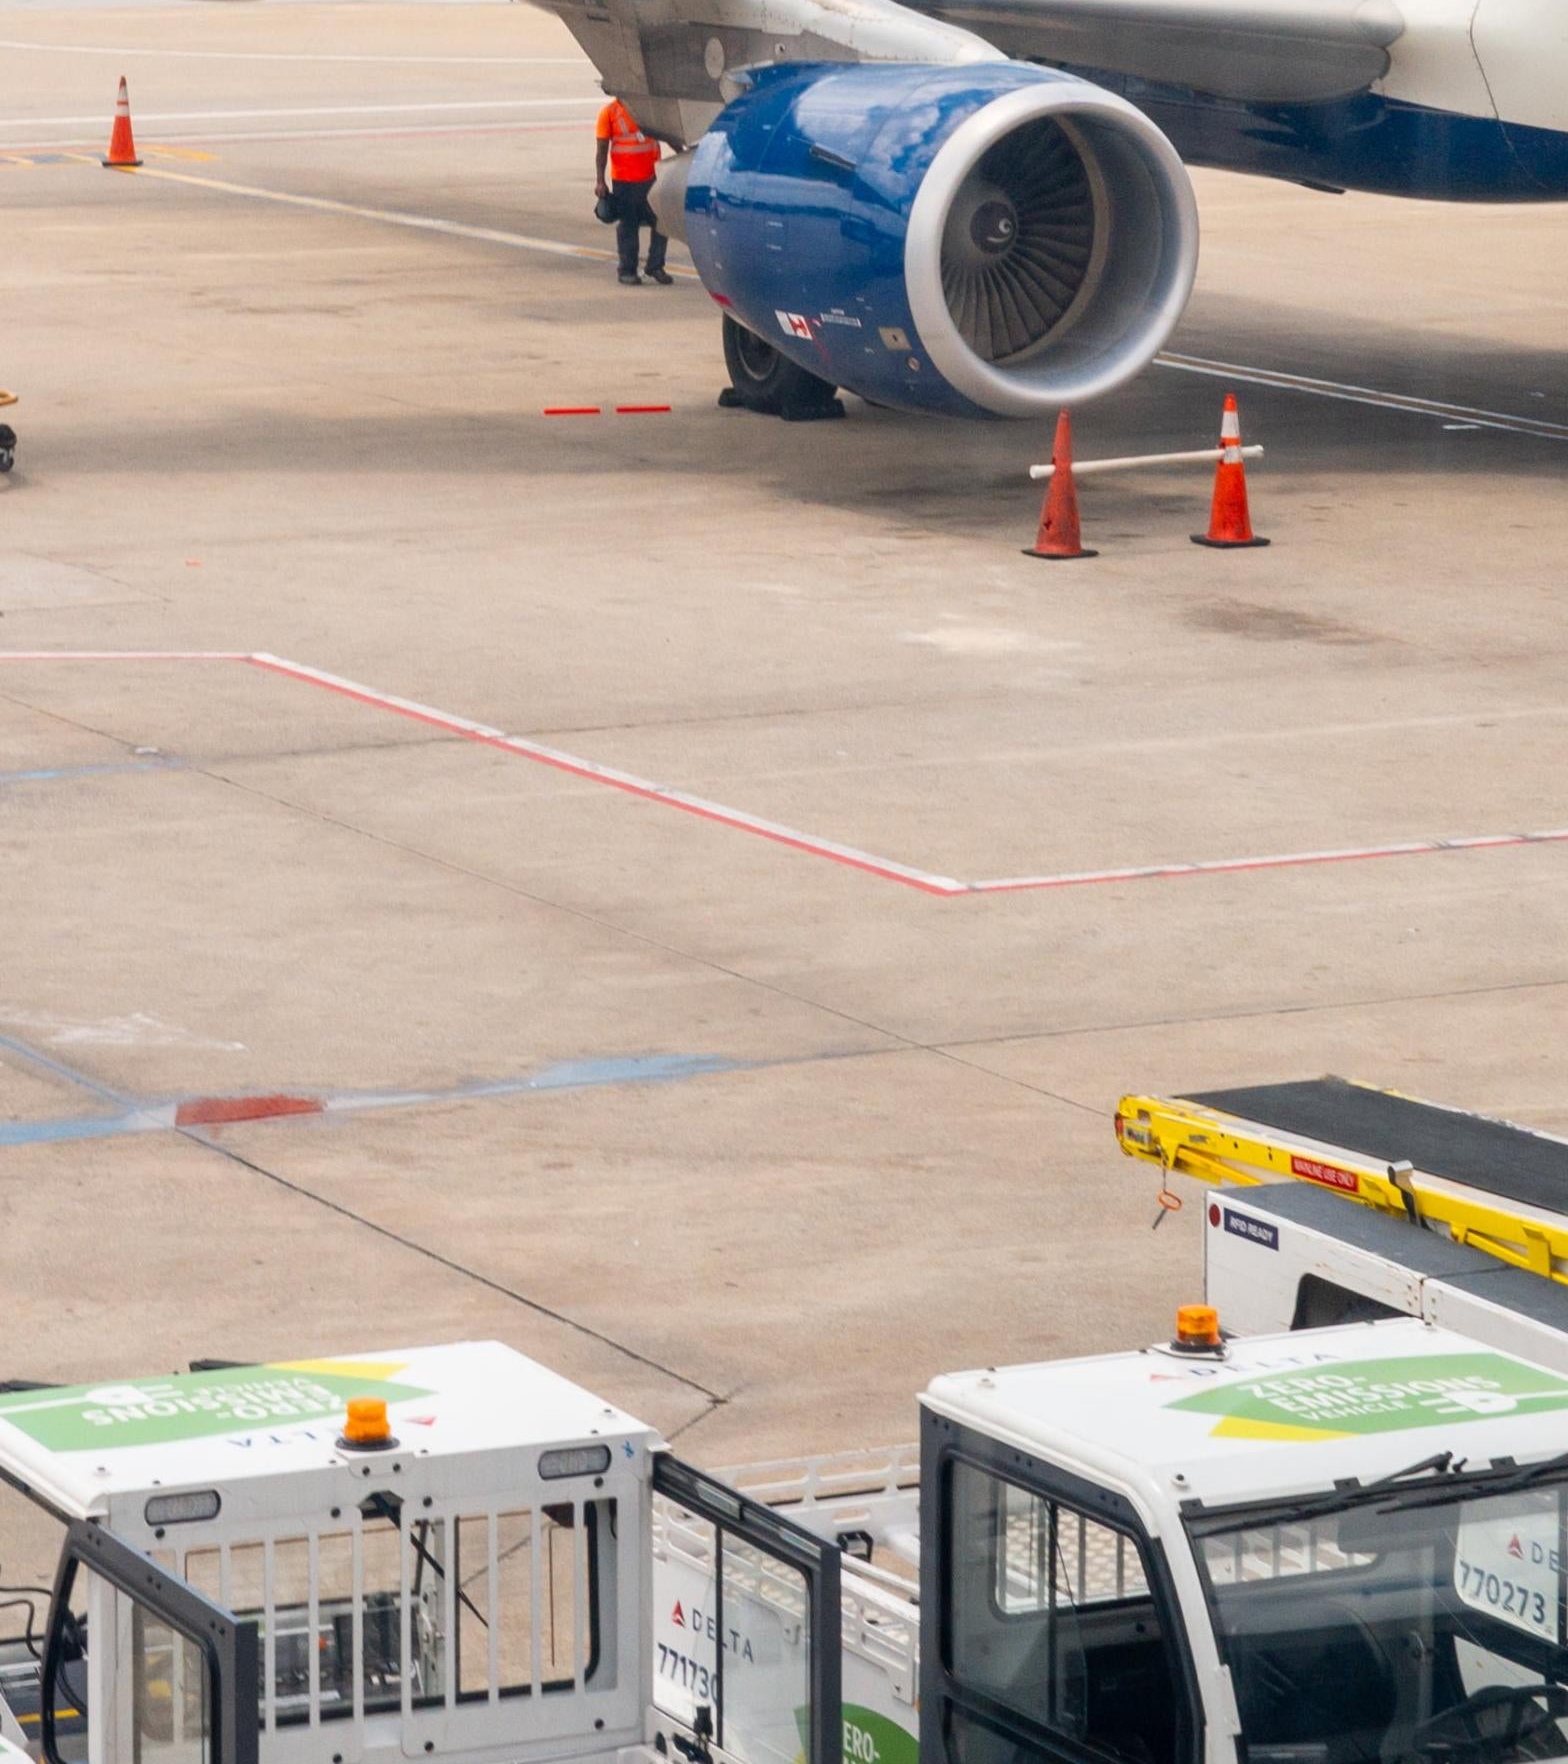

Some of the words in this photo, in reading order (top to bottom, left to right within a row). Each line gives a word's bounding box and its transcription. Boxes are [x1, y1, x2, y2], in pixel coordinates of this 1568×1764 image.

[1190, 1352, 1340, 1377] DELTA
[1239, 1374, 1367, 1399] ZERO-
[1269, 1376, 1501, 1412] EMISSIONS
[1300, 1400, 1414, 1422] VEHICLE
[1459, 1560, 1546, 1625] 770273
[841, 1720, 881, 1762] ERO-
